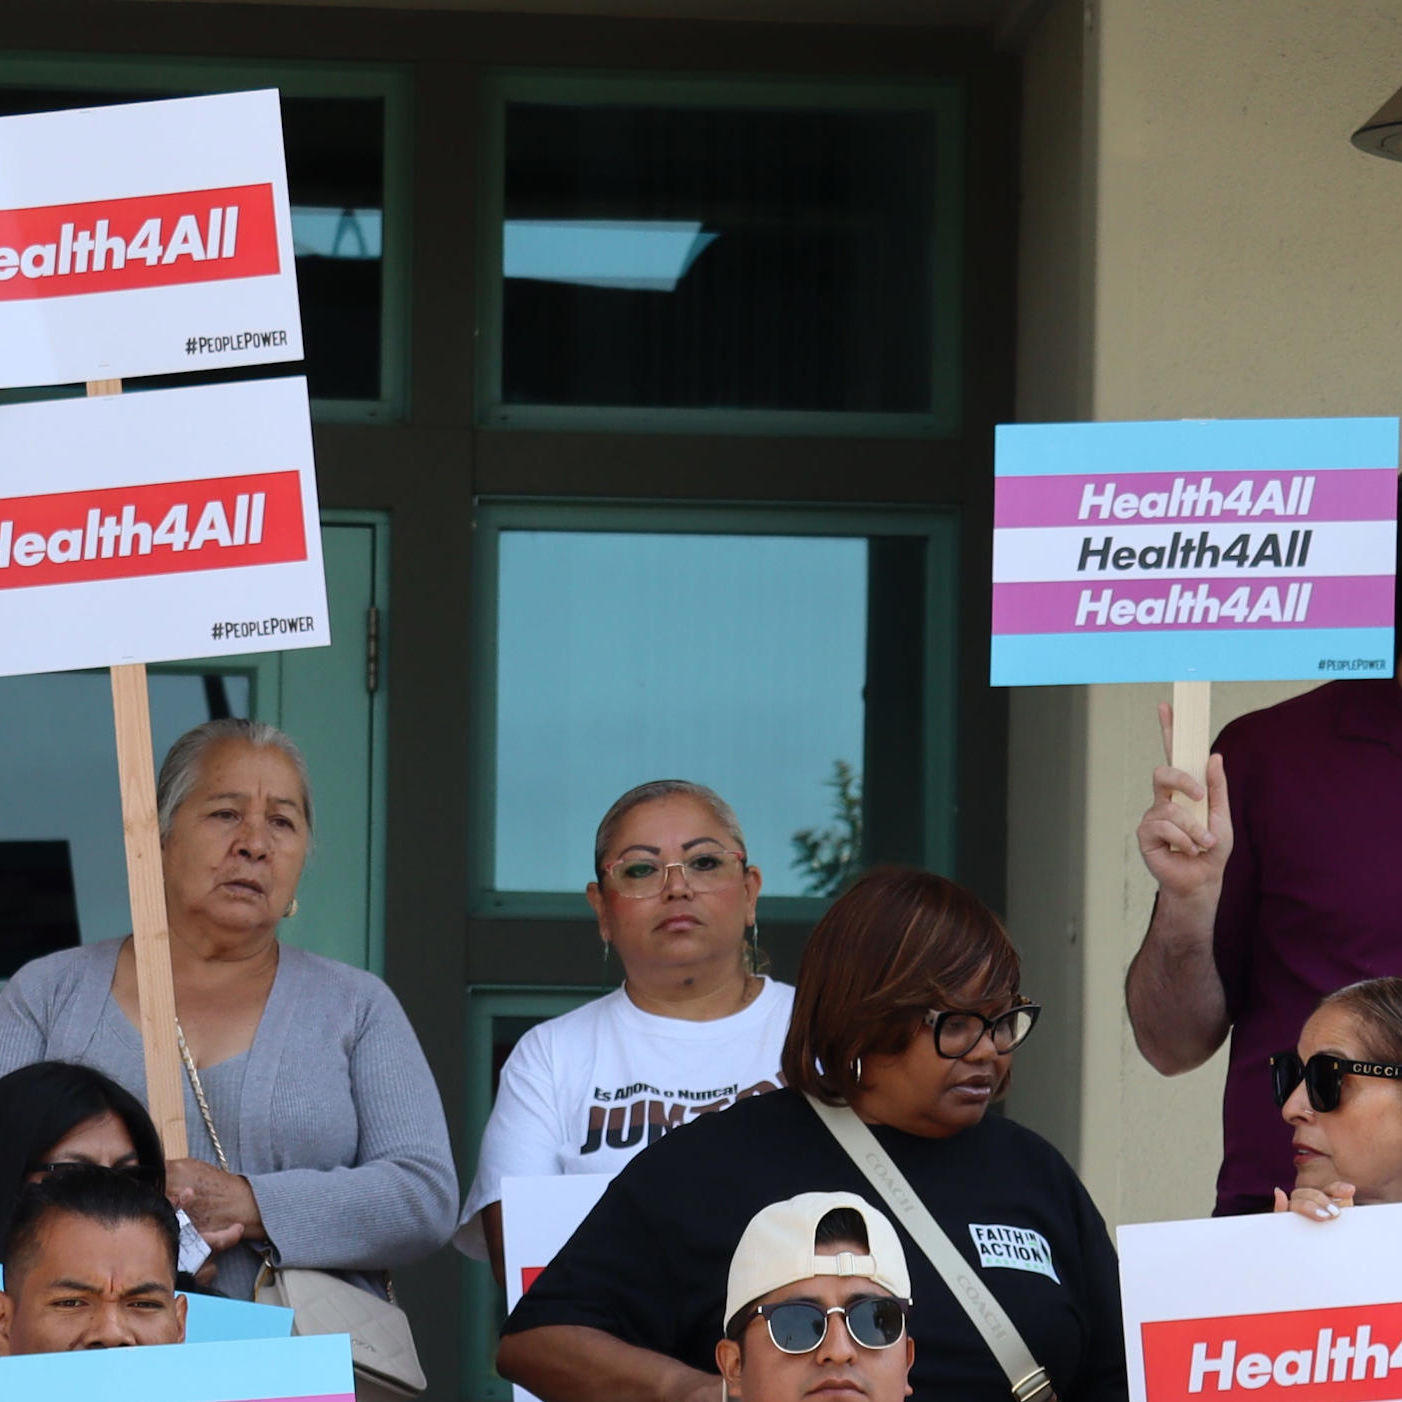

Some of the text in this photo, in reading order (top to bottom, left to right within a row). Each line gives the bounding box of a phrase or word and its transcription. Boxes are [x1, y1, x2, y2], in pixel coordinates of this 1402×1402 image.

[184, 329, 288, 356] #PEOPLEPOWER
[1077, 476, 1317, 522] Health4All
[1077, 529, 1313, 571] Health4All
[1074, 581, 1314, 627] Health4All
[211, 615, 316, 642] #PEOPLEPOWER
[1318, 658, 1386, 673] #PEOPLEPOWER
[663, 1090, 674, 1098] o
[678, 1084, 738, 1101] Nunca!
[975, 1227, 1025, 1245] FAITH
[980, 1243, 1044, 1263] ACTION
